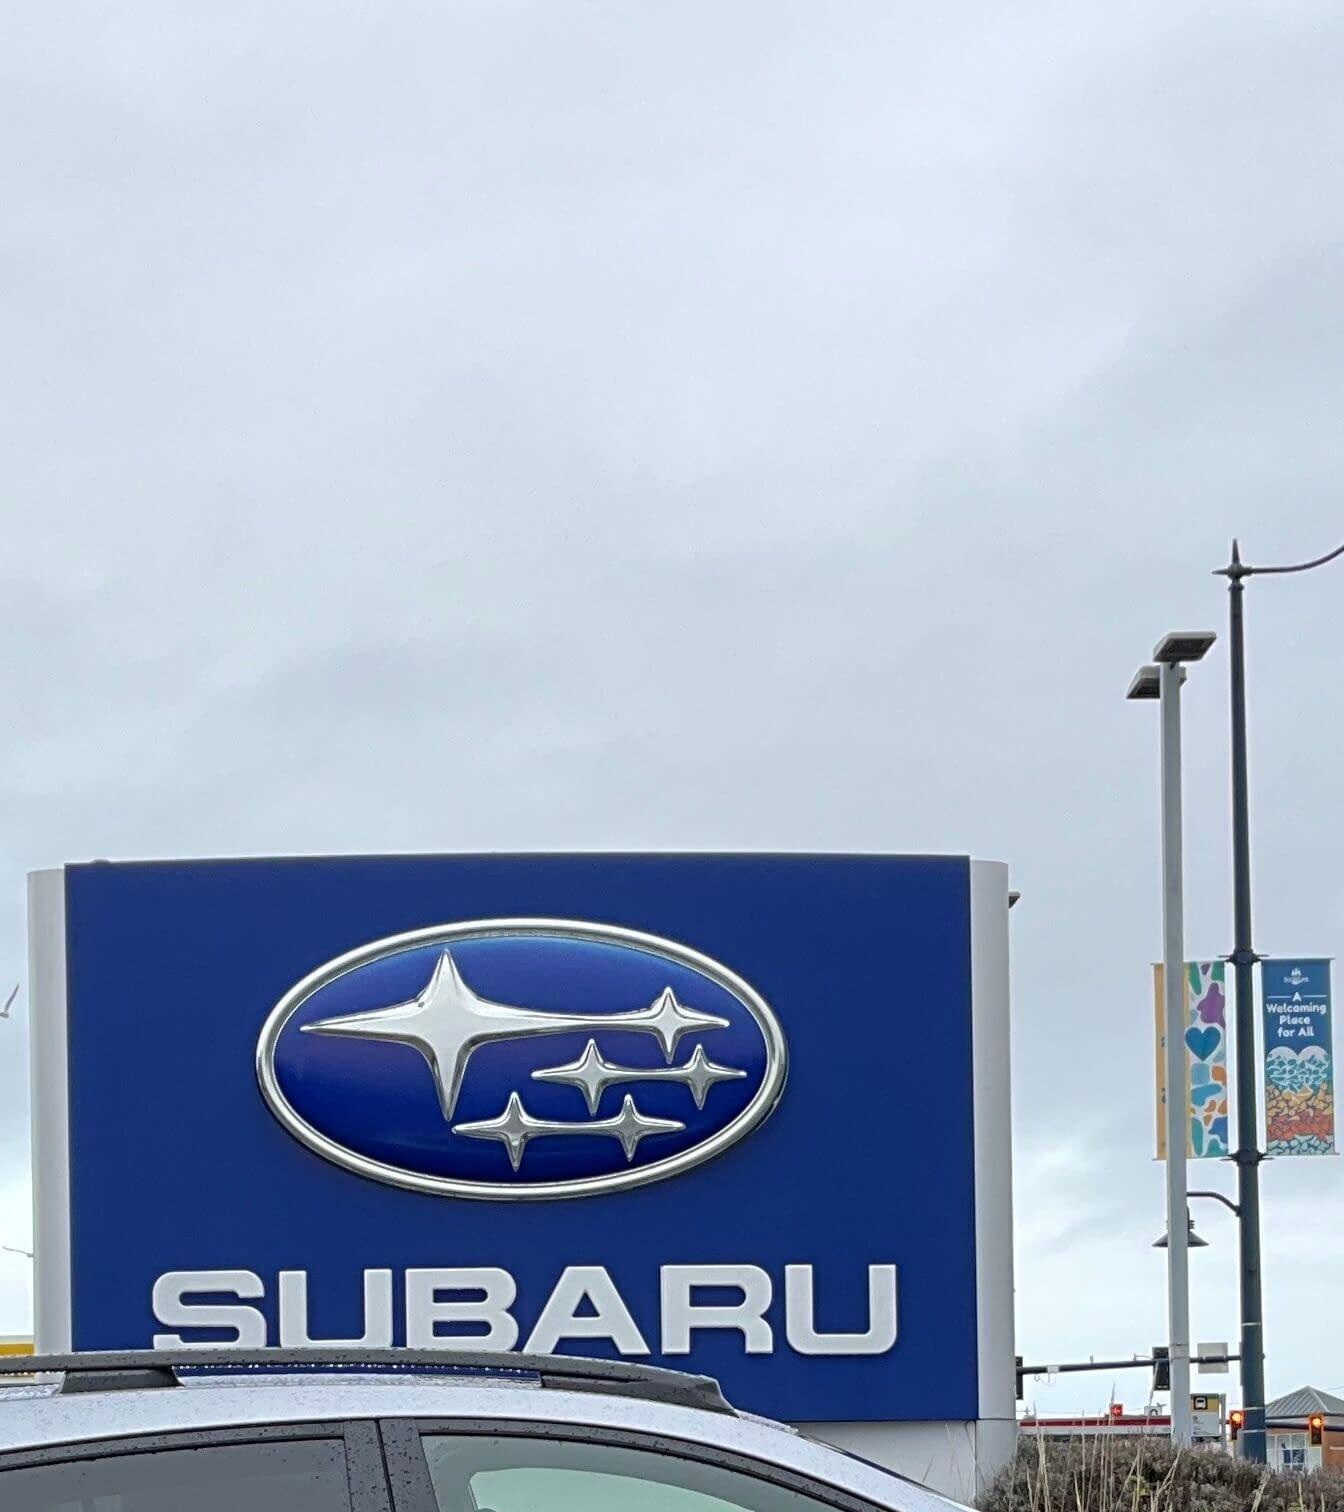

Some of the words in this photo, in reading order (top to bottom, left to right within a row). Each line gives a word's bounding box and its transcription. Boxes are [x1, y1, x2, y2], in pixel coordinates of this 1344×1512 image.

[1293, 991, 1302, 1002] A
[1266, 1002, 1327, 1014] Welcoming
[1279, 1015, 1311, 1025] Place
[1277, 1026, 1295, 1037] for
[1298, 1026, 1315, 1037] All
[152, 1263, 898, 1356] SUBARU
